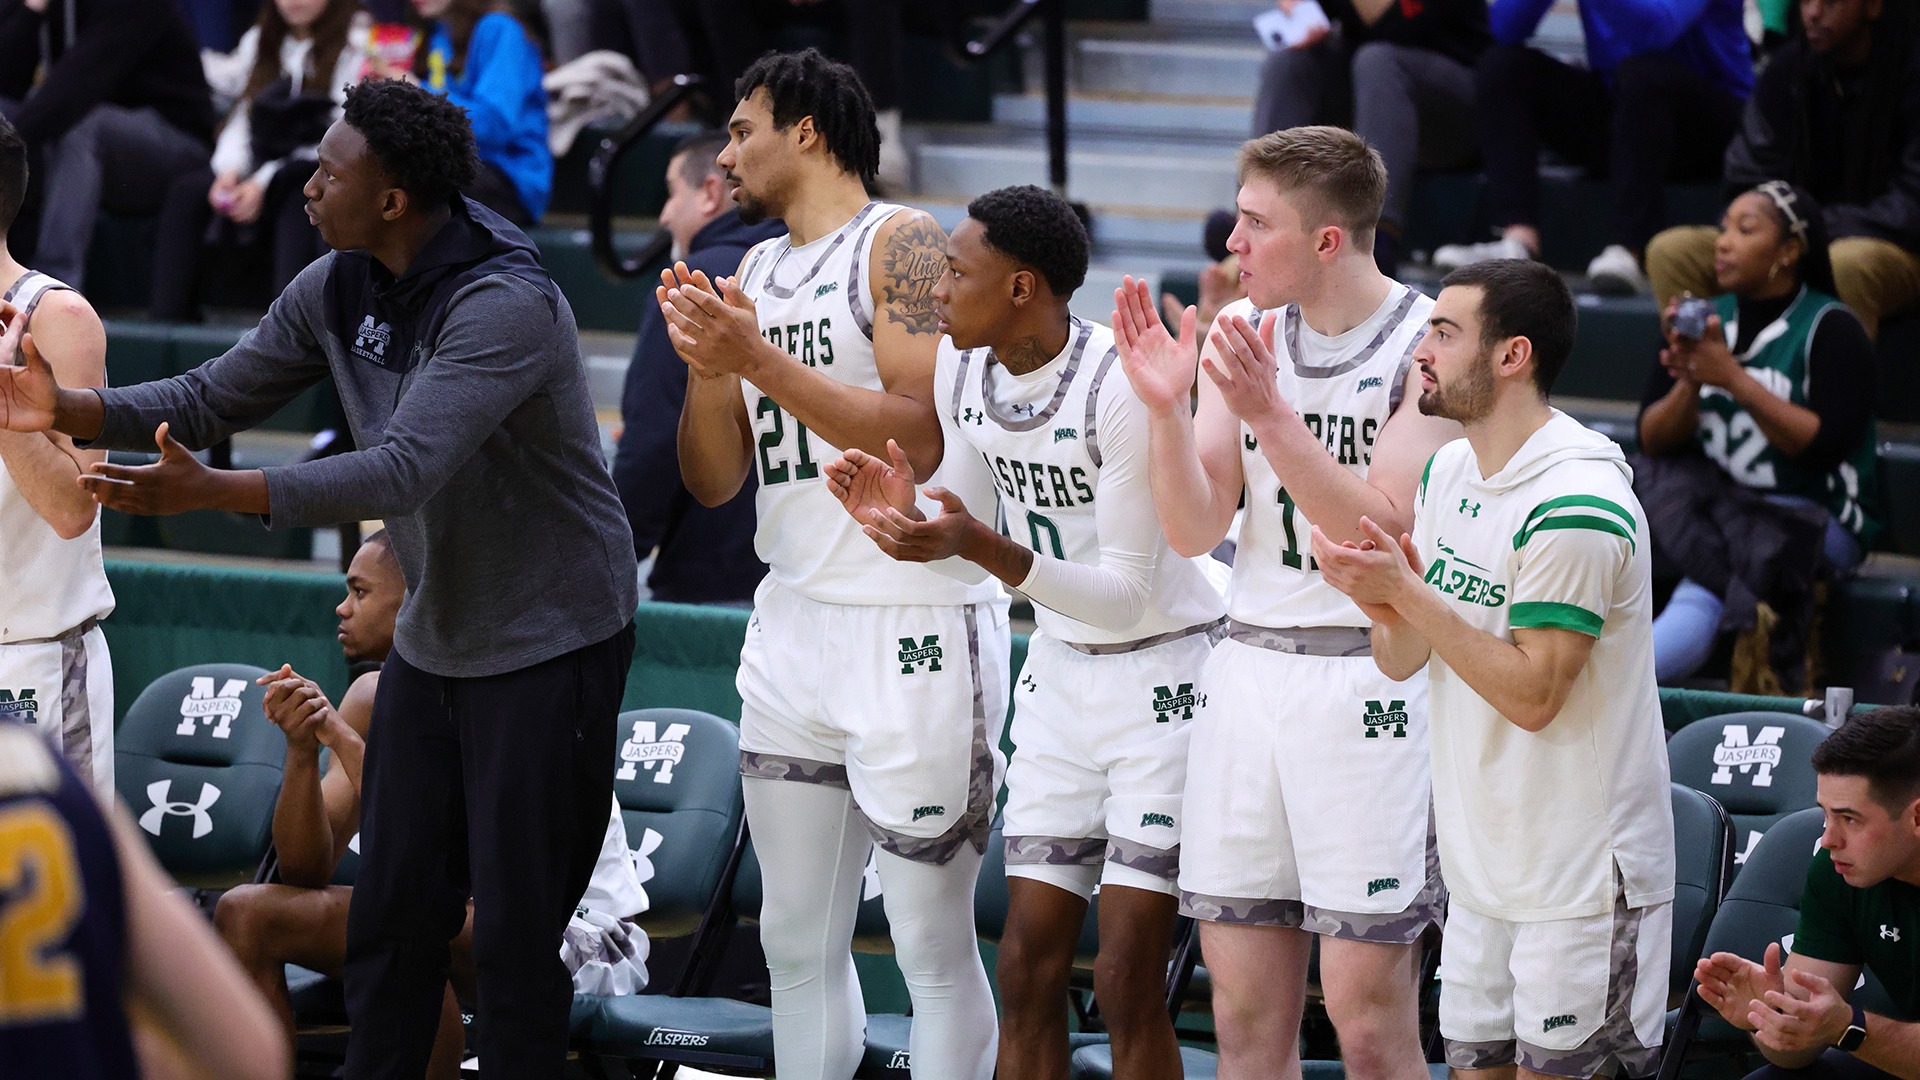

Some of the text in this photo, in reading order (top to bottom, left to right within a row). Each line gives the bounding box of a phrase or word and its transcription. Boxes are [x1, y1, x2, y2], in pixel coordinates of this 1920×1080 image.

[359, 325, 389, 342] JASPERS
[762, 317, 834, 367] PERS
[350, 344, 386, 366] BASKETBALL
[757, 395, 819, 486] 21
[1054, 427, 1078, 444] MAAC
[1276, 485, 1320, 571] 1
[898, 634, 943, 675] M
[902, 647, 940, 662] JASPERS
[0, 701, 36, 712] JASPERS
[176, 676, 248, 739] M
[185, 700, 238, 714] JASPERS
[1153, 682, 1195, 723] M
[1156, 696, 1193, 711] JASPERS
[1364, 700, 1408, 738] M
[1366, 713, 1406, 725] JASPERS
[616, 720, 692, 784] M
[626, 744, 680, 759] JASPERS
[1711, 725, 1786, 788] M
[1718, 747, 1777, 762] JASPERS
[911, 805, 946, 822] MAAC
[1140, 812, 1175, 828] MAAC
[1367, 877, 1400, 897] MAAC
[1543, 1014, 1577, 1033] MAAC
[643, 1029, 709, 1046] JASPERS
